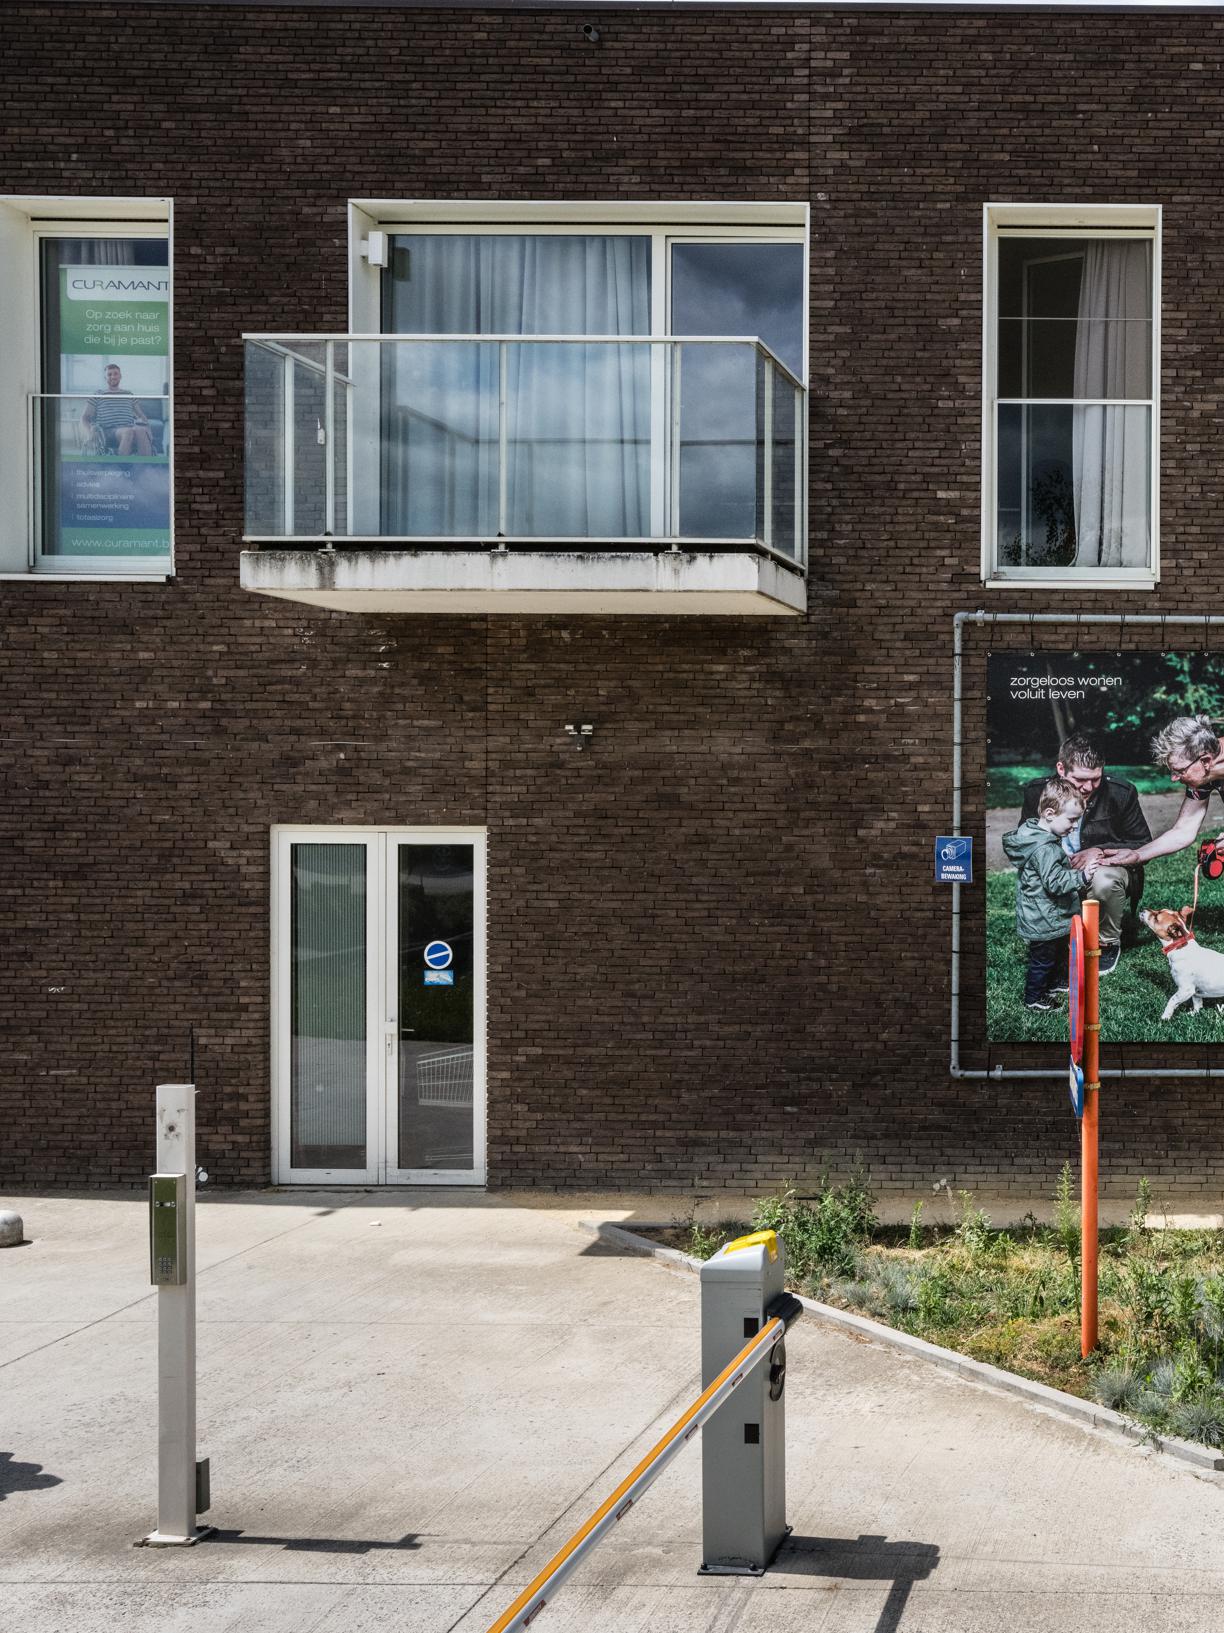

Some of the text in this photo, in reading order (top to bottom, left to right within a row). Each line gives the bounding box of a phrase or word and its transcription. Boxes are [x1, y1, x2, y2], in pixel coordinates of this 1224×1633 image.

[72, 279, 168, 291] CURAMANT
[85, 309, 160, 322] Op zoek naar
[86, 325, 111, 334] zorg
[138, 323, 160, 333] huis
[84, 335, 162, 347] die bij je past?
[1010, 675, 1122, 688] zorgeloos wonen
[1010, 688, 1085, 699] voluit leven
